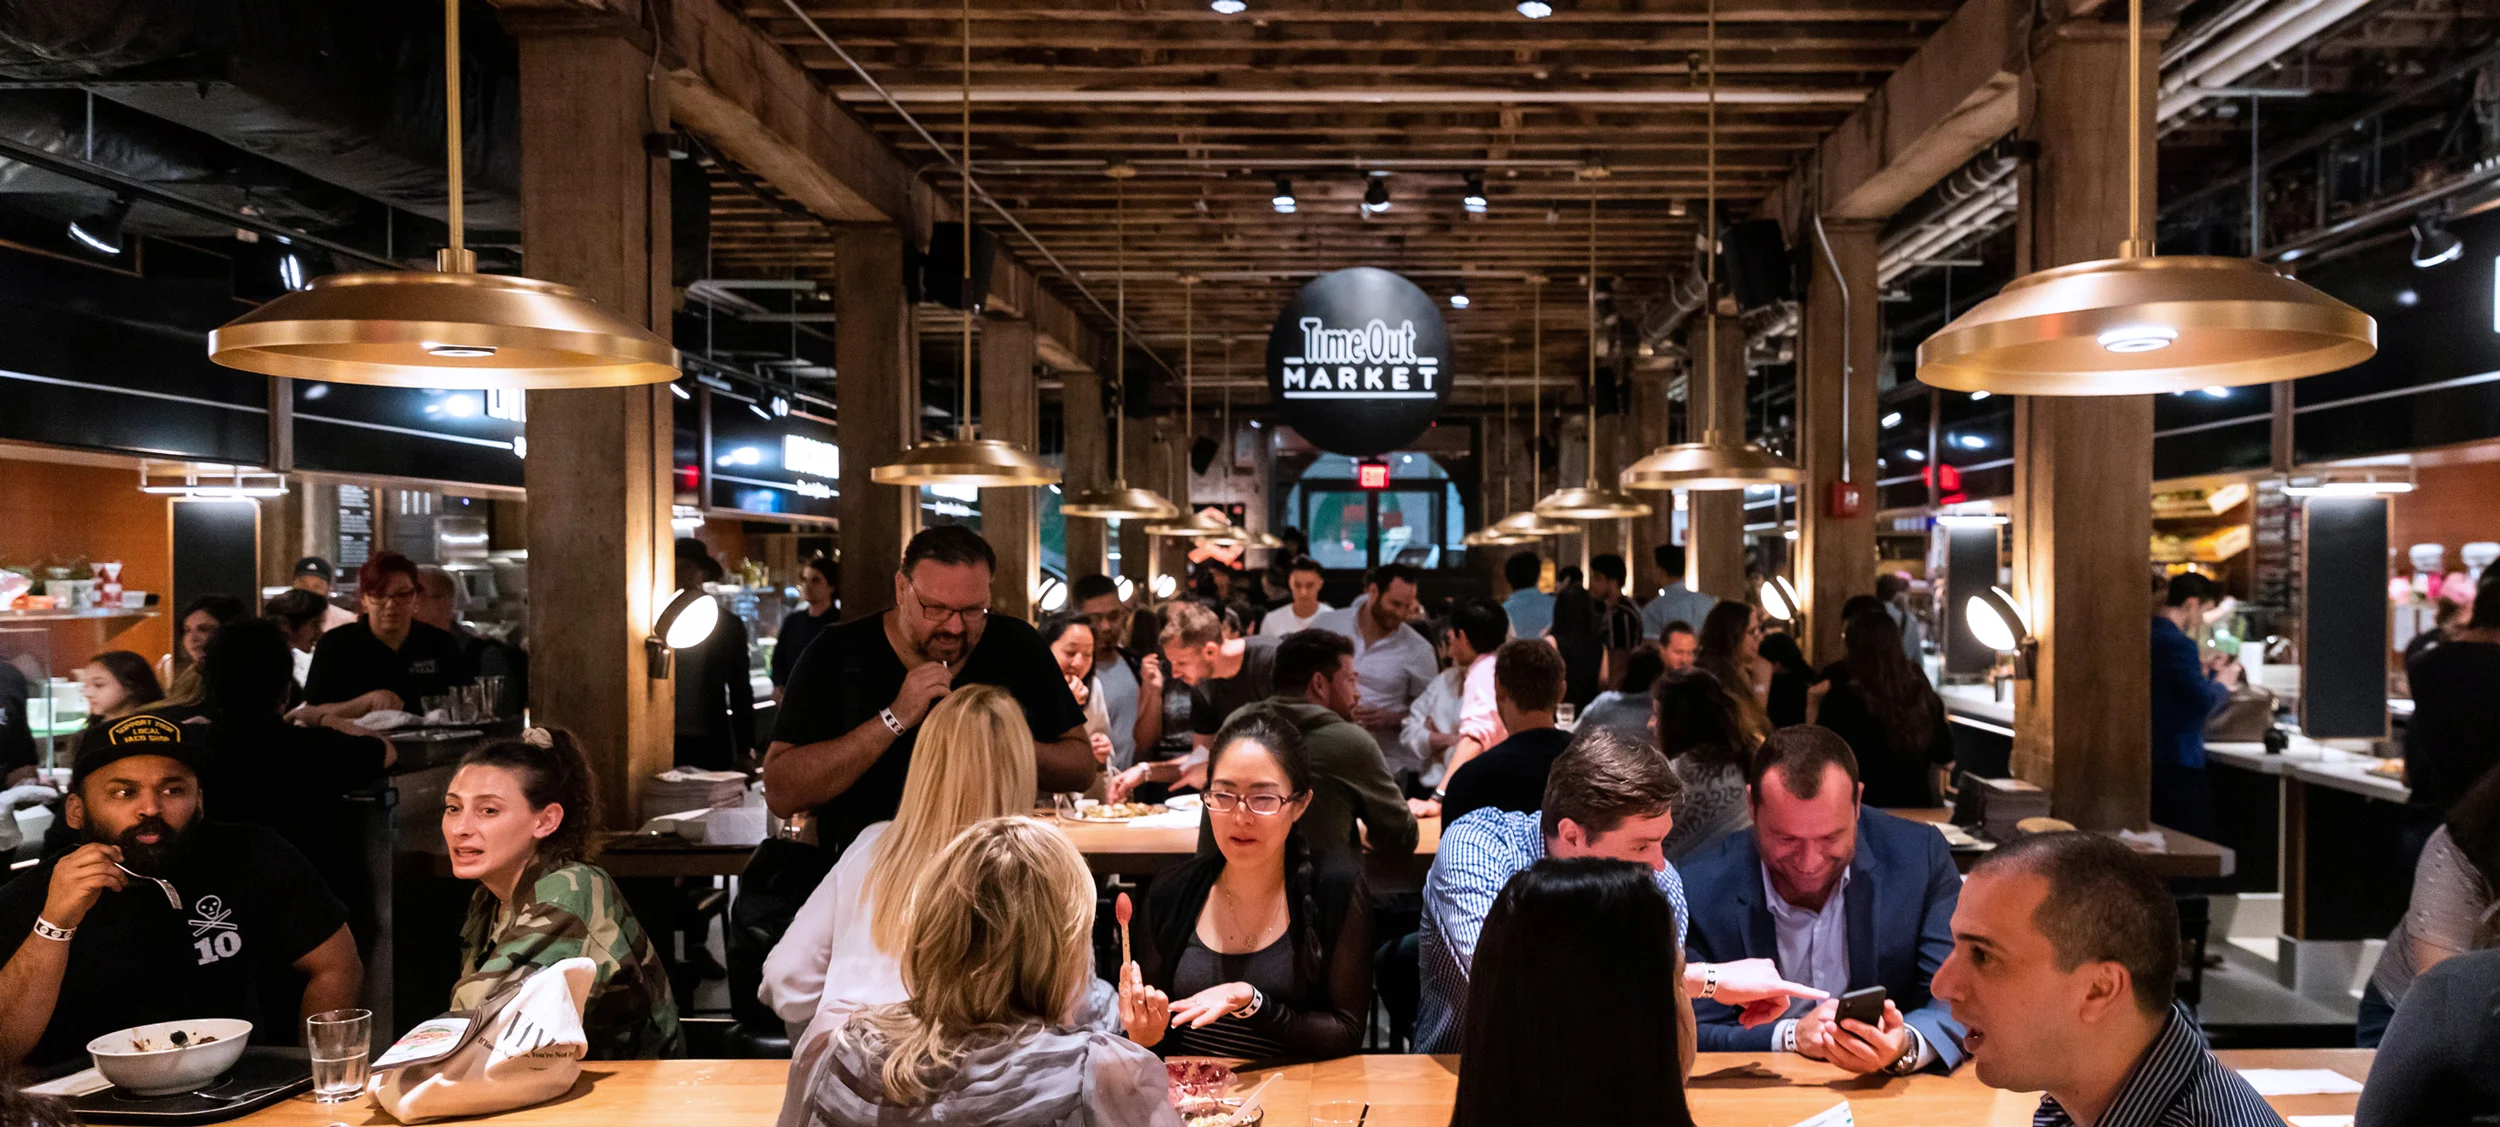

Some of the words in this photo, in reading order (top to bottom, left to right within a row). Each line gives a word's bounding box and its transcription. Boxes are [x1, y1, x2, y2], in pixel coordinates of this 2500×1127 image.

[1283, 367, 1438, 390] MARKET
[1361, 465, 1387, 487] ET
[115, 720, 152, 734] SUPPORT
[124, 735, 147, 743] TACO
[194, 931, 241, 965] 10
